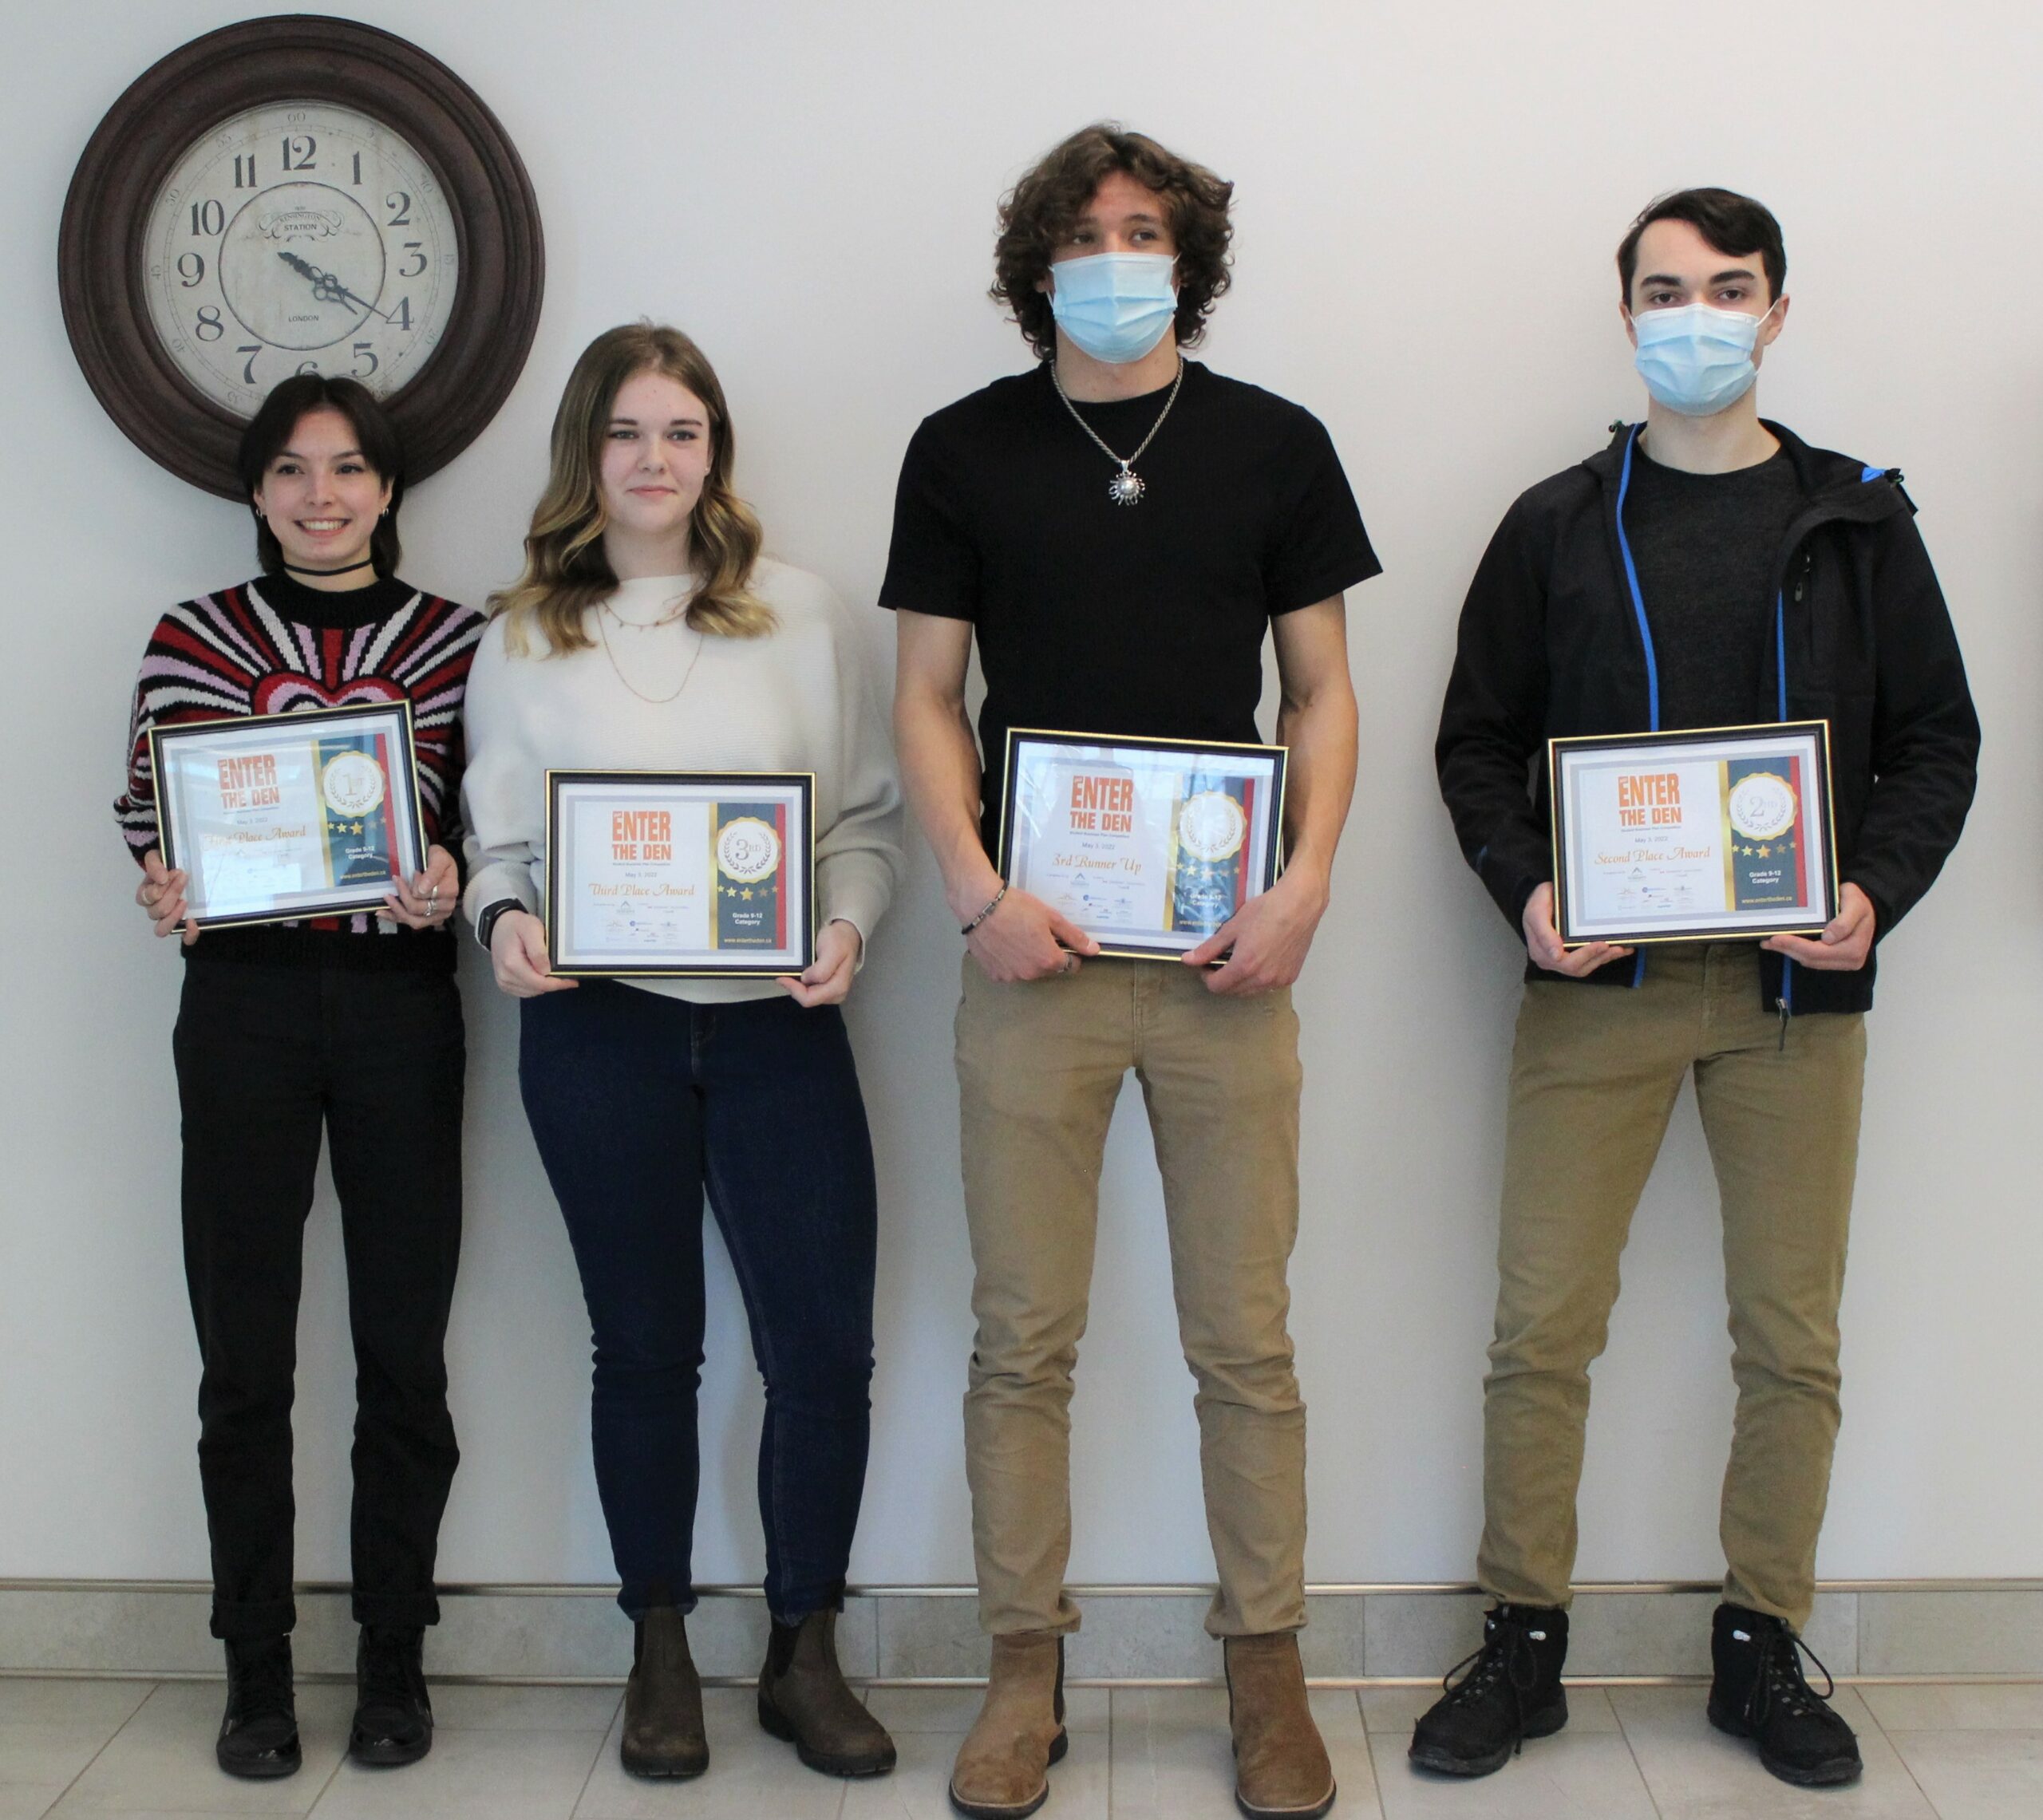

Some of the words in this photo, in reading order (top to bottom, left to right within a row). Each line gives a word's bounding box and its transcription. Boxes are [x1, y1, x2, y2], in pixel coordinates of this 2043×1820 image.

[234, 153, 258, 188] 11
[282, 135, 316, 171] 12
[352, 151, 363, 185] 1
[191, 199, 225, 236] 10
[386, 191, 411, 227] 2
[177, 252, 205, 288] 9
[399, 242, 427, 277] 3
[196, 305, 224, 342] 8
[385, 296, 415, 331] 4
[236, 345, 263, 385] 7
[351, 342, 379, 378] 5
[217, 754, 277, 790] ENTER
[221, 791, 247, 809] THE
[251, 787, 280, 806] DEN
[1071, 775, 1133, 812] ENTER
[1618, 773, 1680, 807] ENTER
[234, 831, 263, 843] Place
[266, 825, 306, 841] Award
[612, 811, 671, 842] ENTER
[1070, 811, 1096, 829] THE
[1102, 813, 1132, 832] DEN
[1619, 808, 1646, 827] THE
[1652, 807, 1681, 824] DEN
[612, 843, 638, 860] THE
[643, 843, 672, 860] DEN
[1053, 854, 1073, 867] 3rd
[1075, 855, 1116, 870] Runner
[1120, 857, 1142, 875] Up
[1594, 851, 1630, 864] Second
[1633, 849, 1663, 862] Place
[1666, 846, 1710, 860] Award
[588, 882, 618, 895] Third
[621, 883, 650, 895] Place
[653, 882, 694, 896] Award
